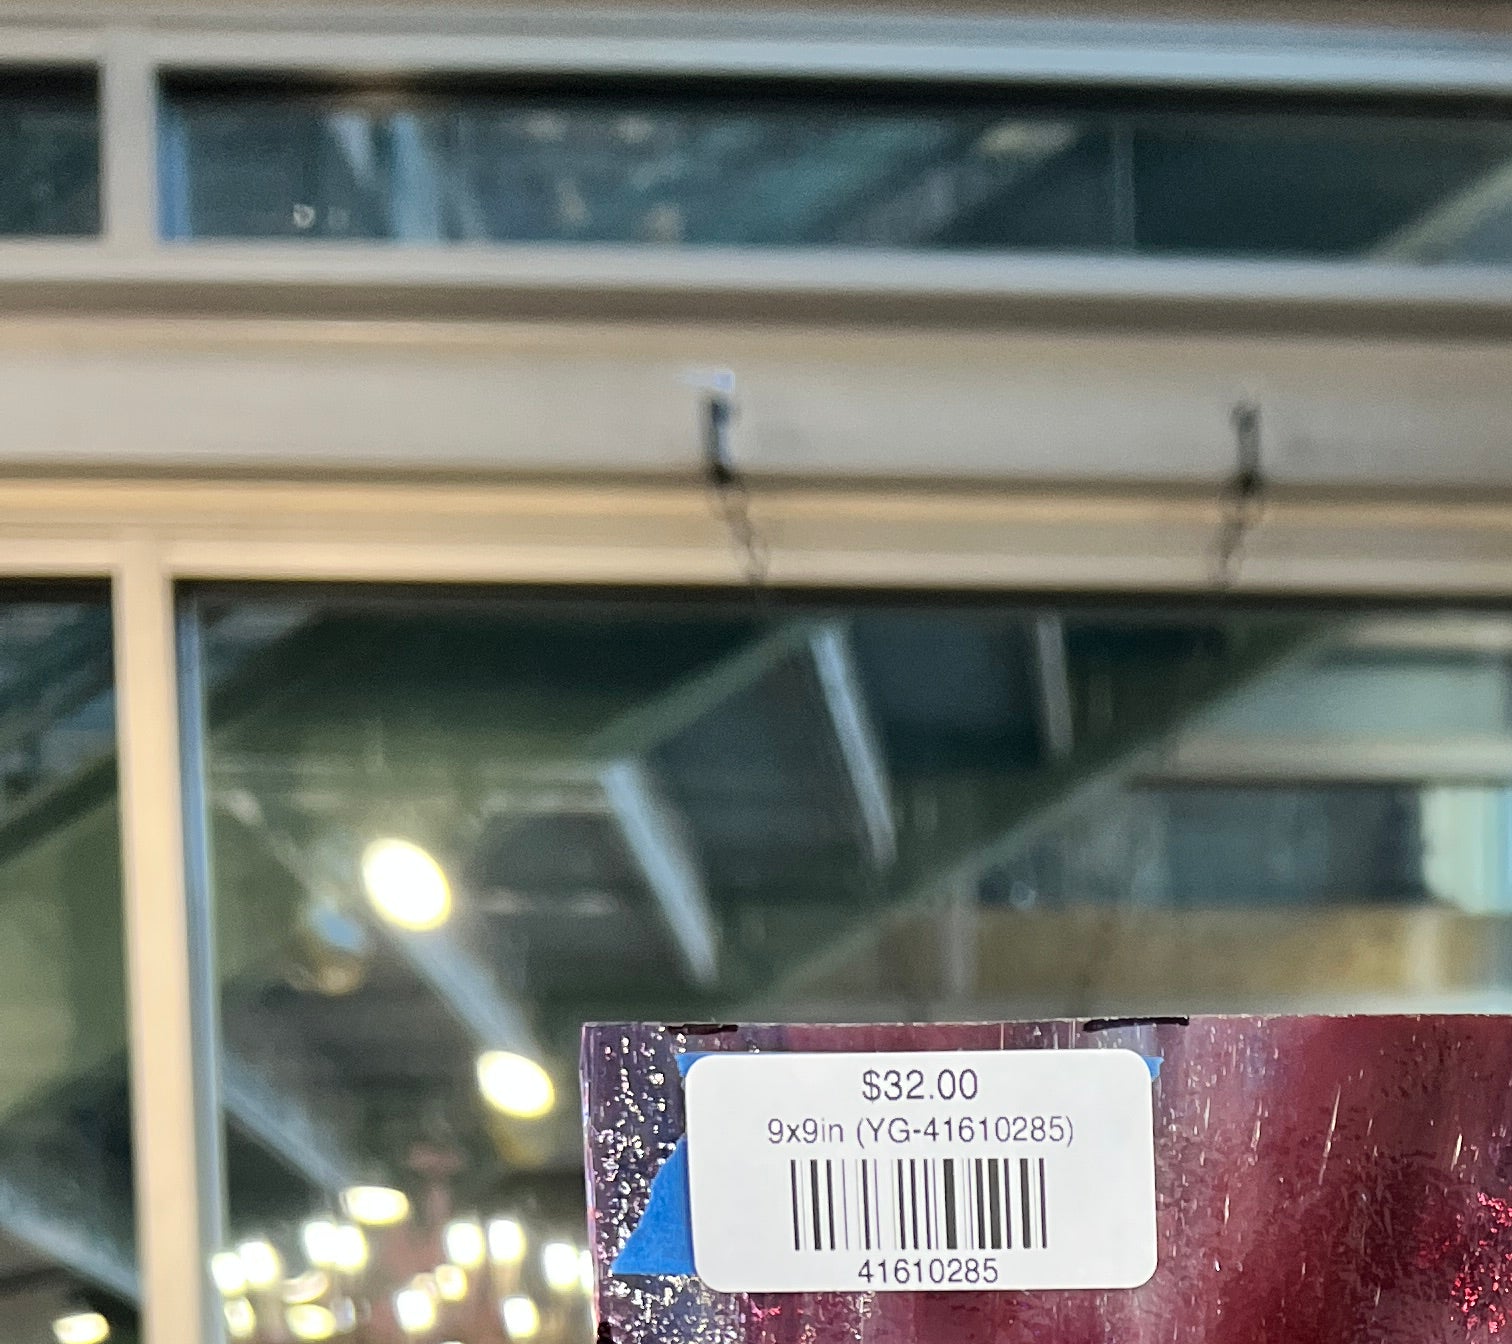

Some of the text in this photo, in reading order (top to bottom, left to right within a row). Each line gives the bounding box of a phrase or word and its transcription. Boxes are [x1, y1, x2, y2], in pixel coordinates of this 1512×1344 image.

[861, 1068, 978, 1103] $32.00
[767, 1115, 1074, 1149] 9x9in (YG-41610285)
[857, 1257, 999, 1285] 41610285
